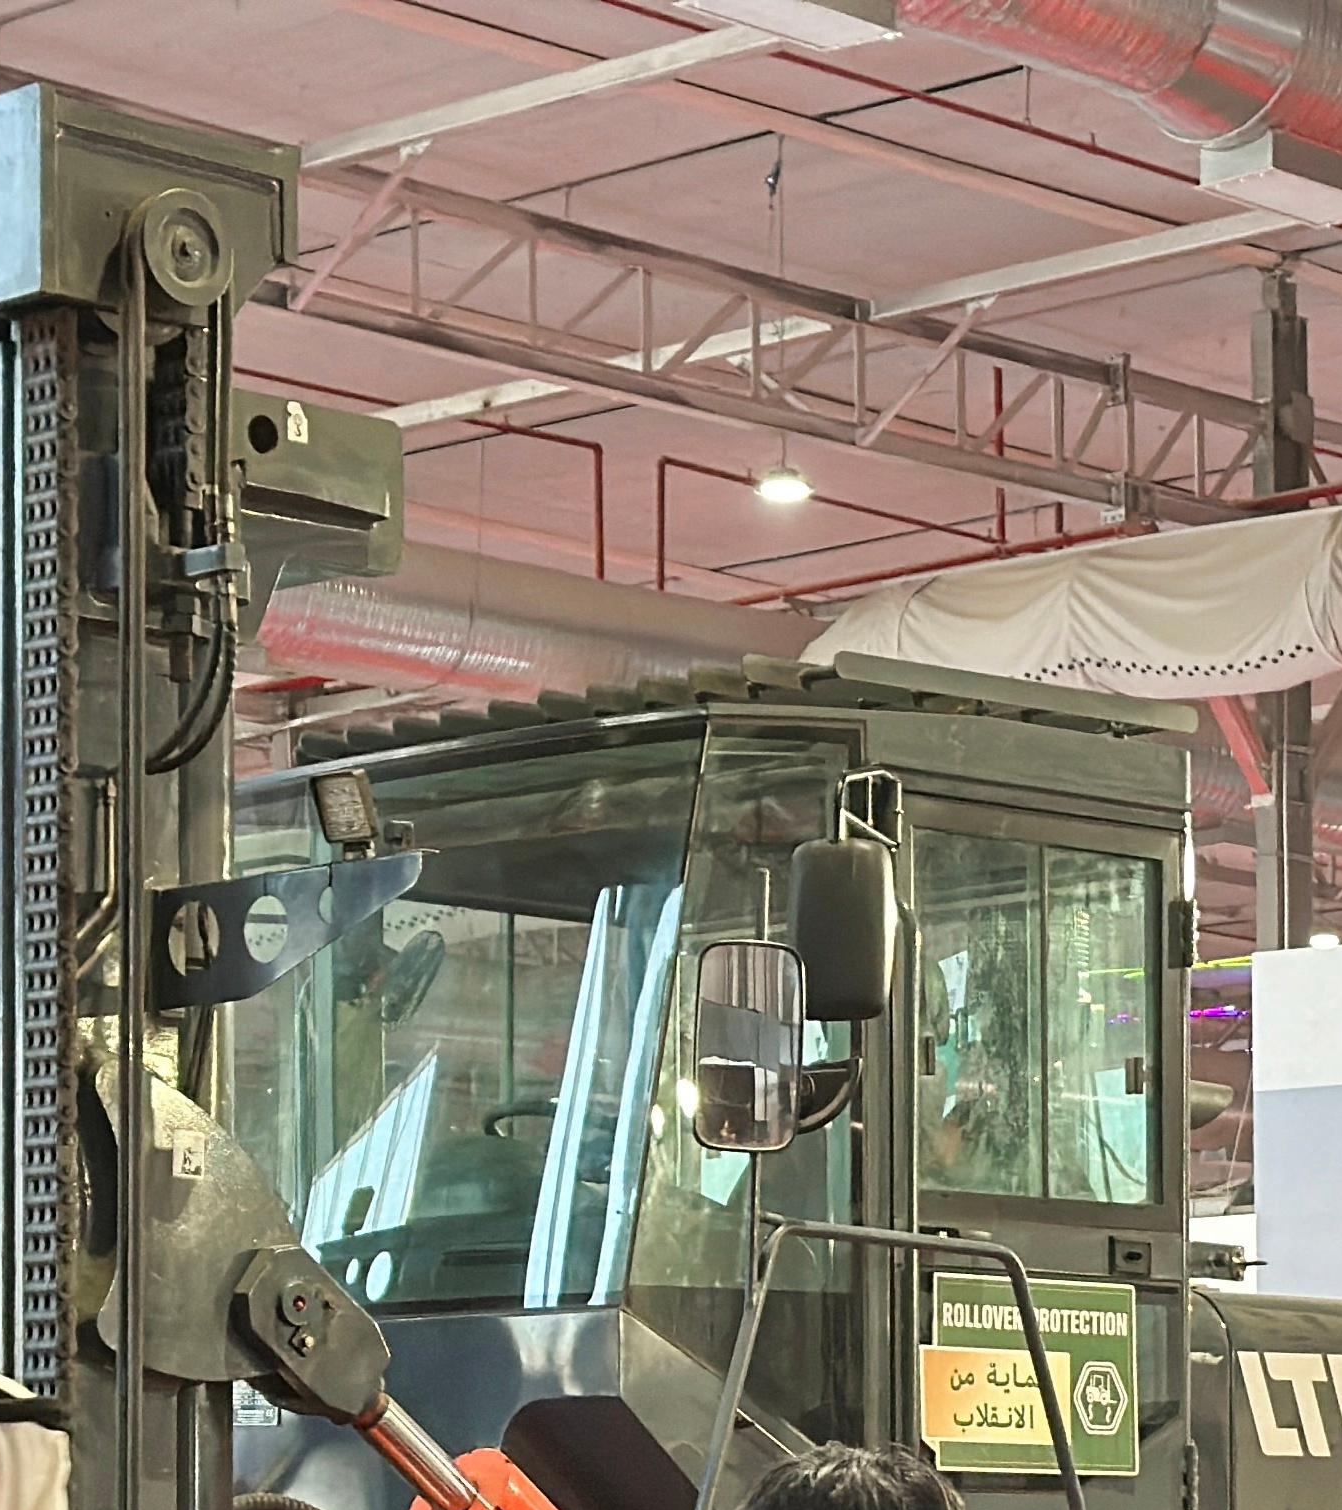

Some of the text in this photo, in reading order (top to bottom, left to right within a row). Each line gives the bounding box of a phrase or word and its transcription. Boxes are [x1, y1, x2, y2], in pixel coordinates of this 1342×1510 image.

[942, 1302, 1024, 1331] ROLLOVER
[950, 1363, 1041, 1394] ماية من
[953, 1402, 1034, 1433] الانقلاب
